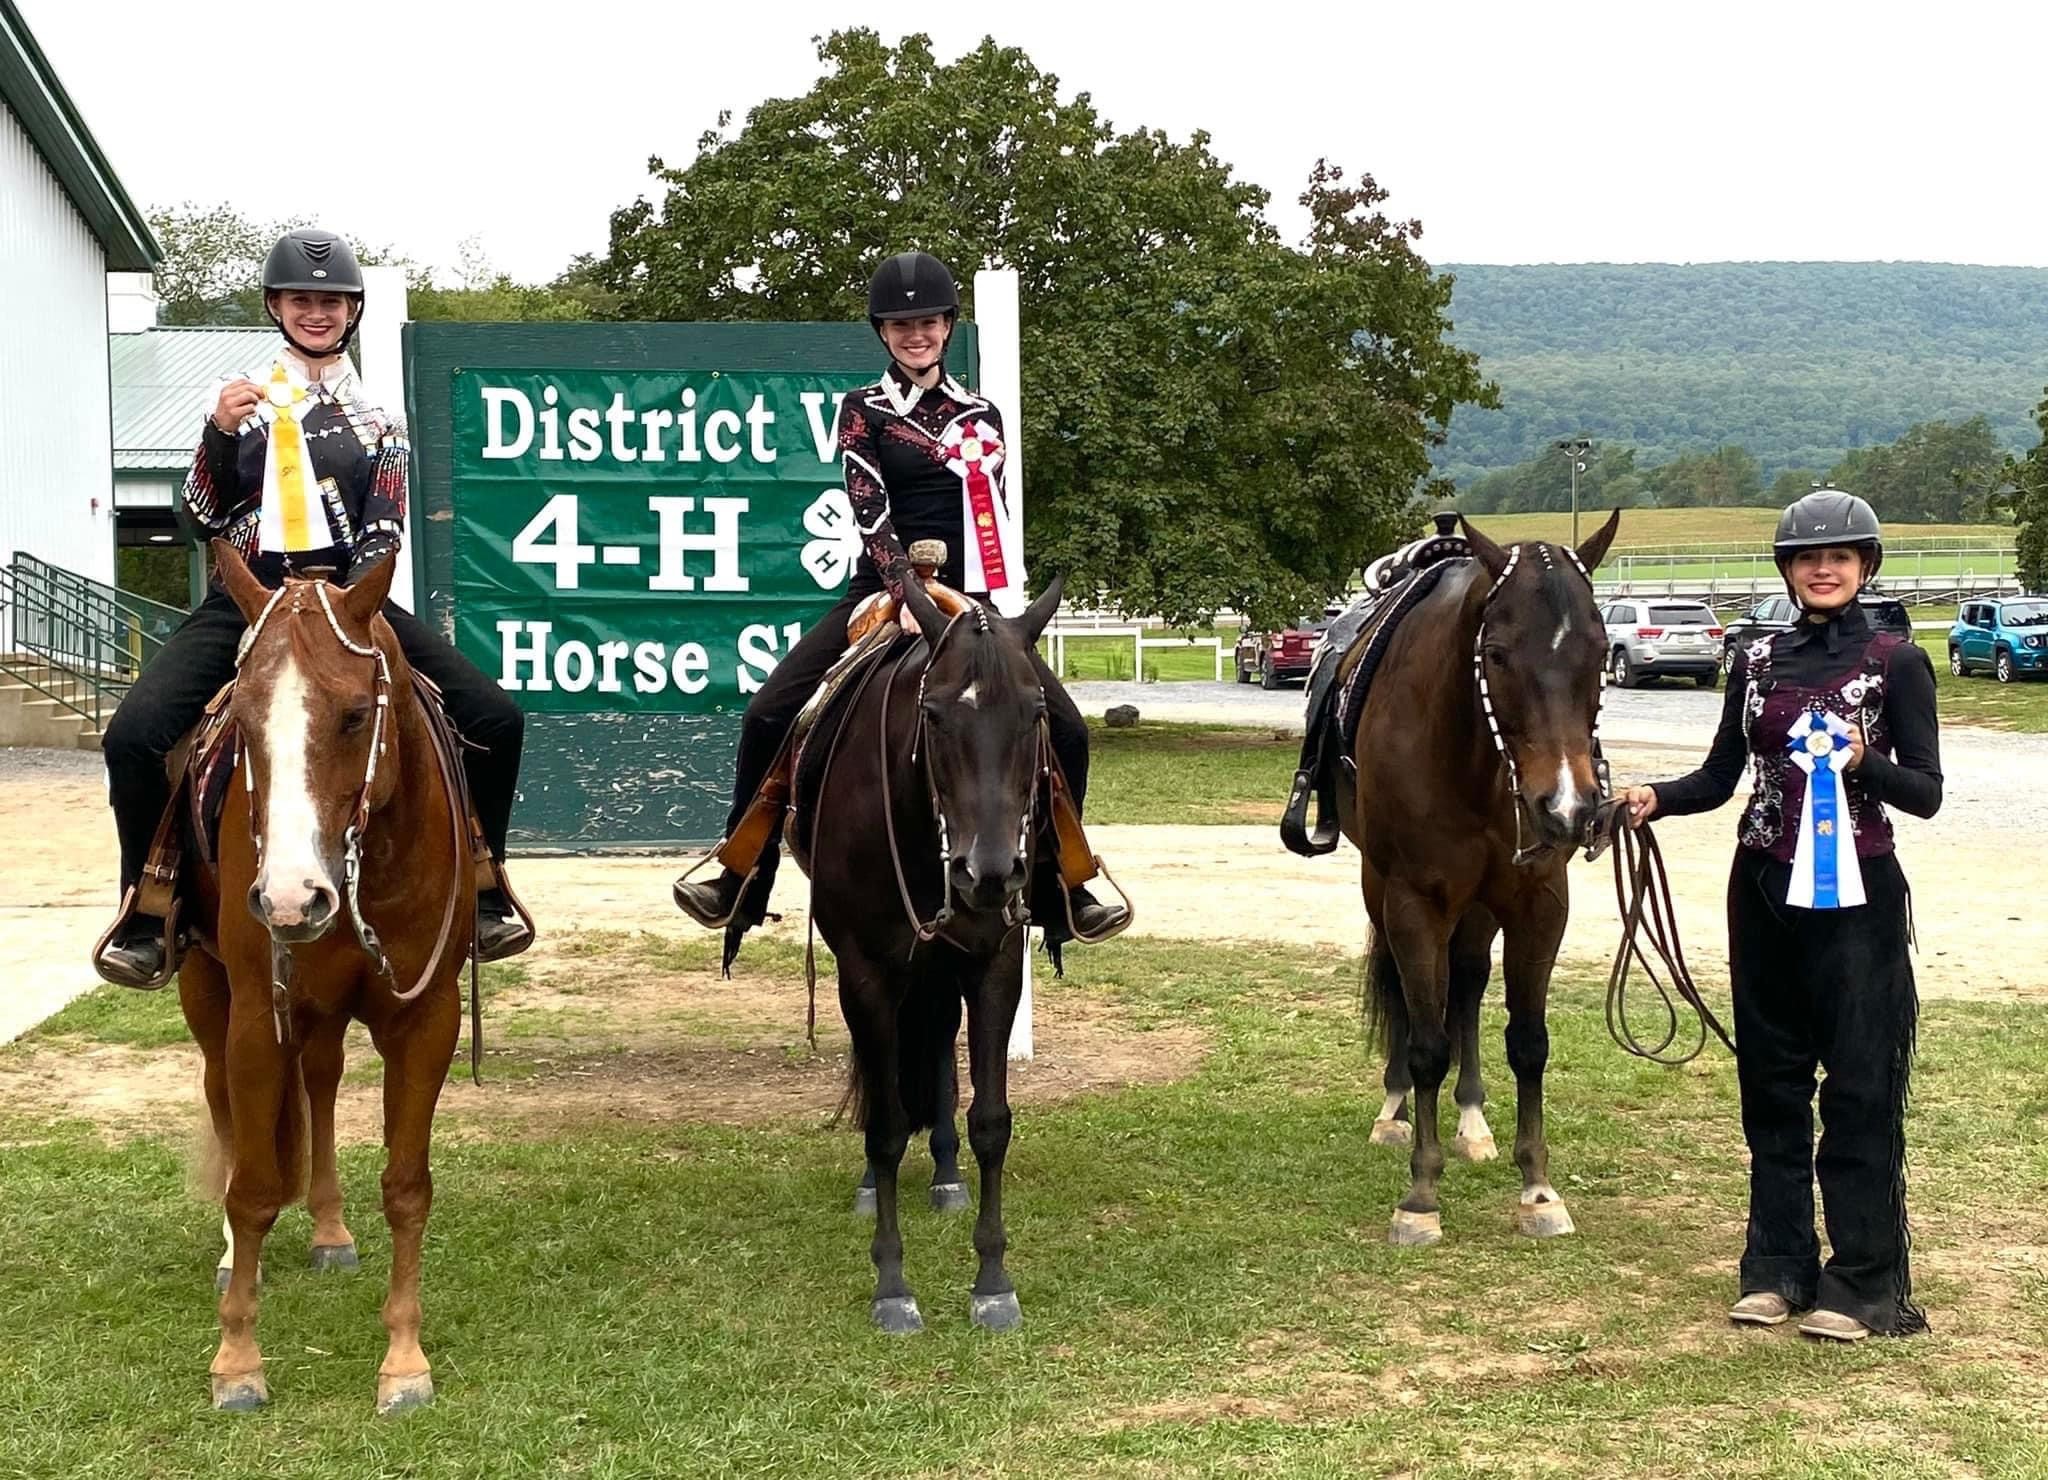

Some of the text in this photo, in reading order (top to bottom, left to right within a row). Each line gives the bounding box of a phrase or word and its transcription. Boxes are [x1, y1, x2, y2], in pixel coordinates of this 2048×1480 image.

[481, 385, 777, 463] District
[512, 494, 749, 592] 4-H
[496, 620, 710, 694] Horse
